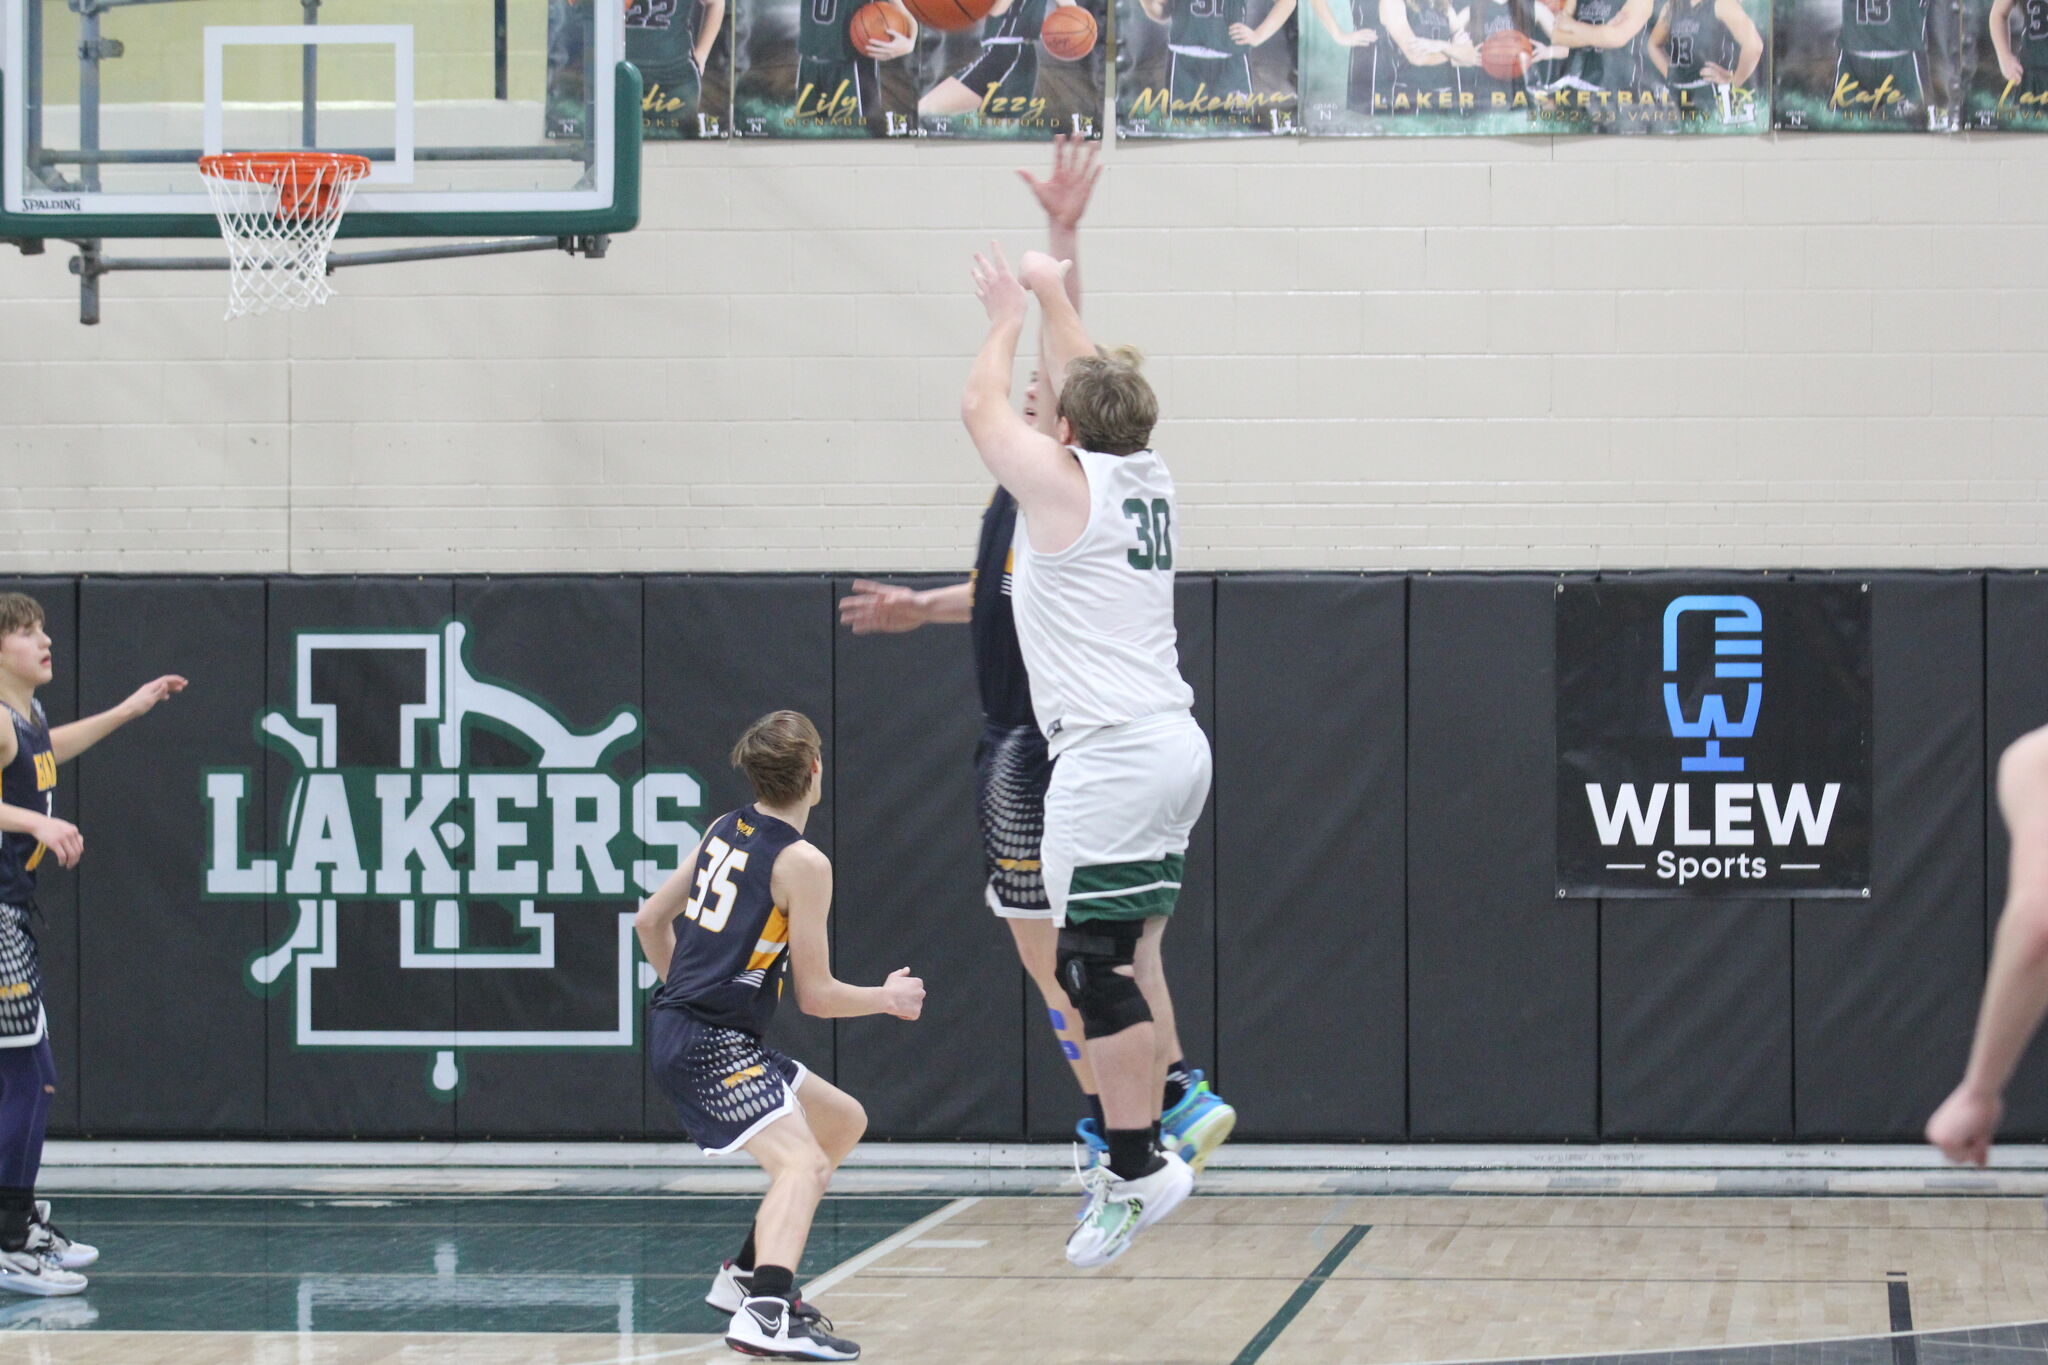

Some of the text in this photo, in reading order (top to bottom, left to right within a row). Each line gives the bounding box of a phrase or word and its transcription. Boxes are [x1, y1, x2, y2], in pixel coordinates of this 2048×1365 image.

[795, 79, 858, 118] Lily
[979, 81, 1047, 119] Izzy
[1128, 82, 1297, 119] Makenna
[1374, 91, 1695, 110] LAKER BASKETBALL
[1829, 72, 1905, 112] Kate
[1628, 111, 1712, 121] VARSITY
[22, 198, 81, 212] SPALDING
[1121, 498, 1173, 571] 30
[206, 772, 702, 894] LAKERS
[1585, 782, 1841, 846] WLEW
[684, 835, 749, 933] 35
[1656, 850, 1767, 885] Sports
